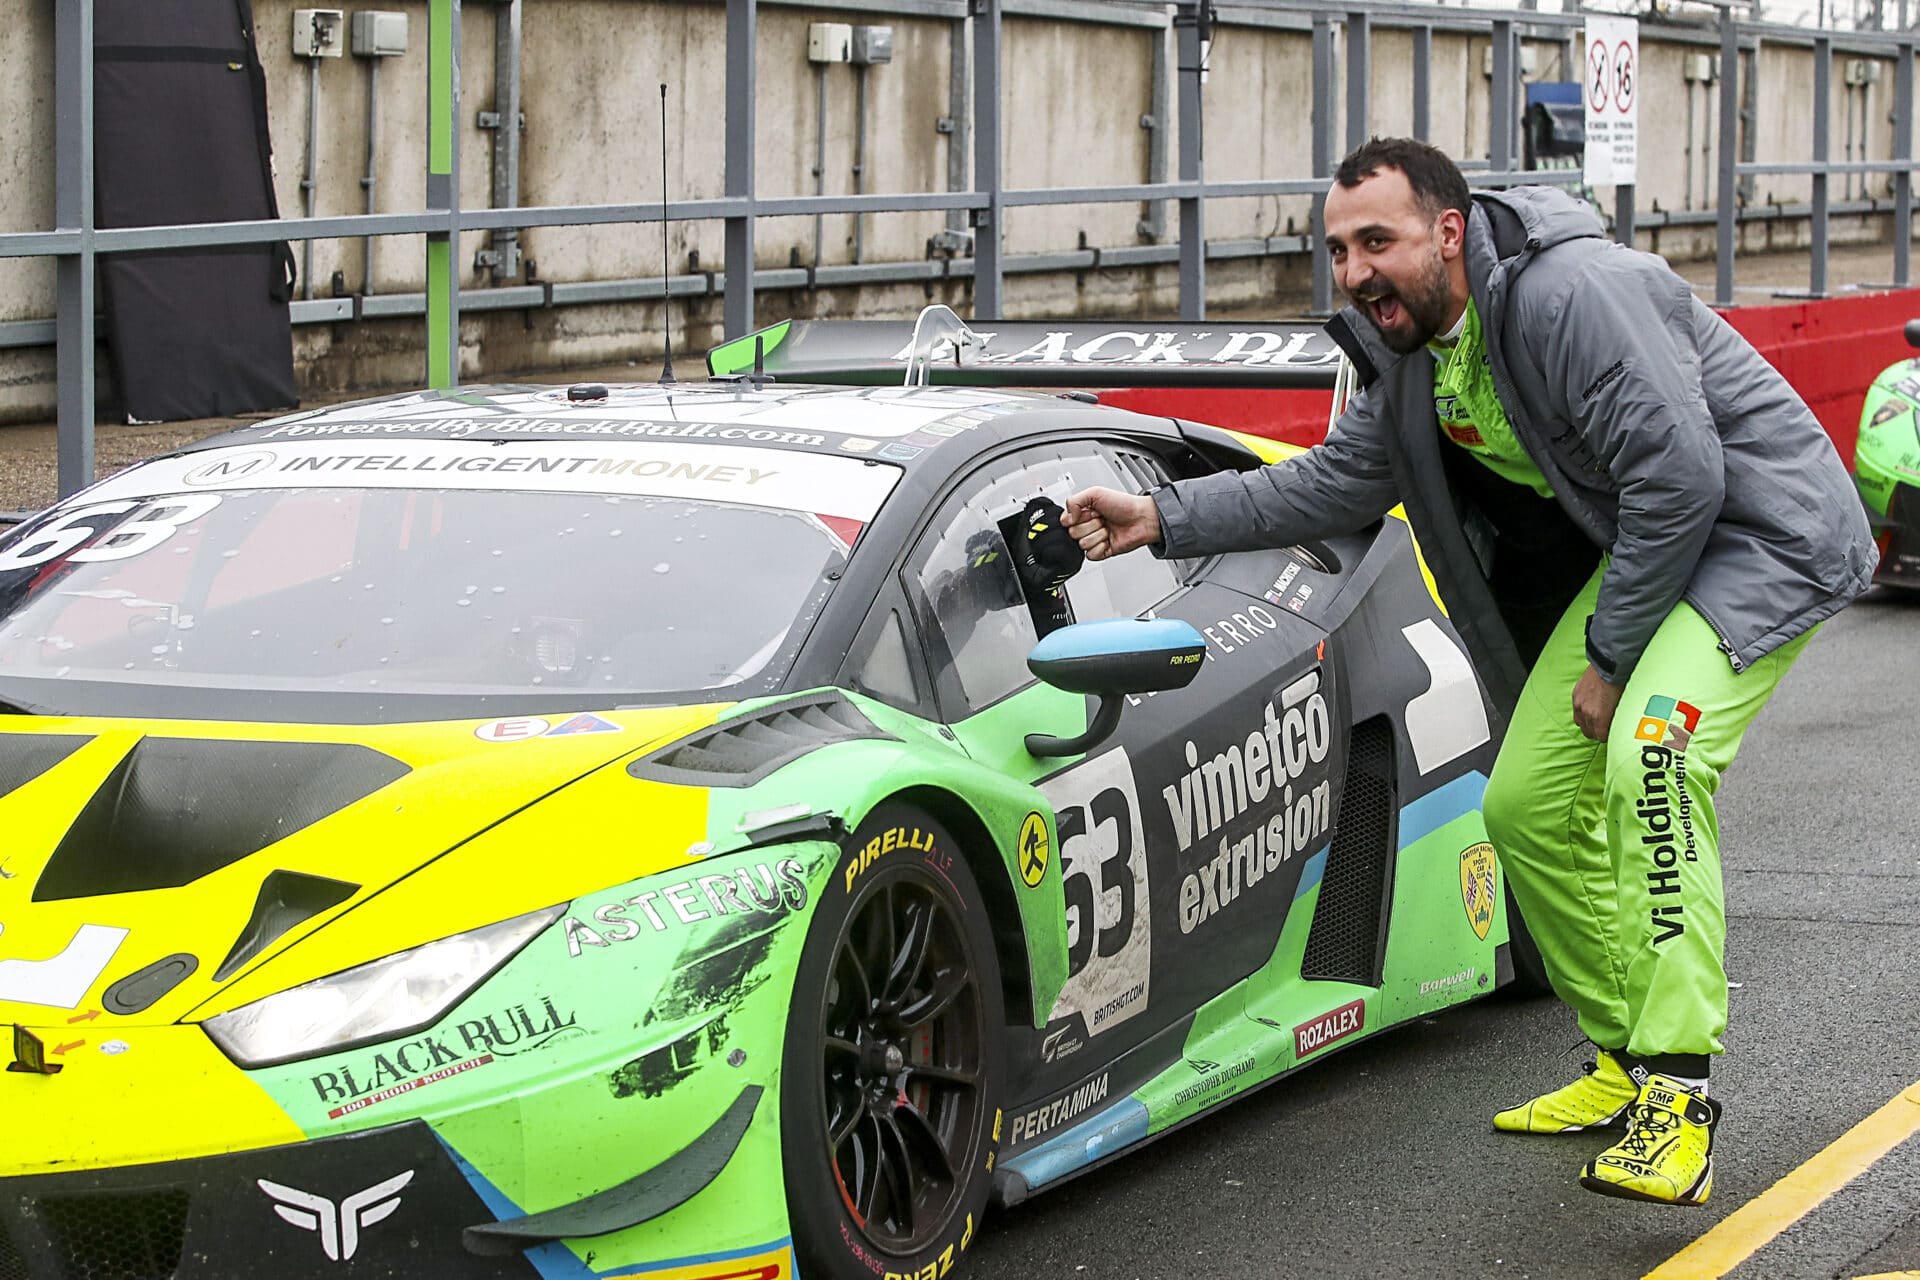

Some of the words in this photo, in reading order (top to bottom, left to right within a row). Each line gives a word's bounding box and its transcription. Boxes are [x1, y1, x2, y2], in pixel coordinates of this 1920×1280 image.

[890, 331, 1211, 362] BACK
[1203, 605, 1277, 662] ERRO
[1170, 655, 1184, 665] FOR
[494, 721, 532, 738] E
[1162, 692, 1330, 853] vimetco
[1635, 745, 1682, 896] Holding
[1674, 754, 1698, 862] Development
[845, 826, 935, 894] PIRELLI
[1178, 779, 1331, 935] extrusion
[563, 859, 808, 958] ASTERUS
[1651, 905, 1685, 948] Vi
[1093, 981, 1145, 1027] BRITISHGT.COM
[311, 1035, 463, 1103] BLACK
[456, 996, 576, 1053] BULL
[1299, 1006, 1359, 1052] ROZALEX
[341, 1100, 366, 1115] 100
[369, 1079, 418, 1104] PROOF
[1174, 1073, 1221, 1106] CHRISTOPHE
[1220, 1057, 1256, 1085] DUCHAMP
[1647, 1090, 1675, 1105] OMP
[1011, 1072, 1109, 1145] PERTAMINA
[960, 1211, 973, 1251] P
